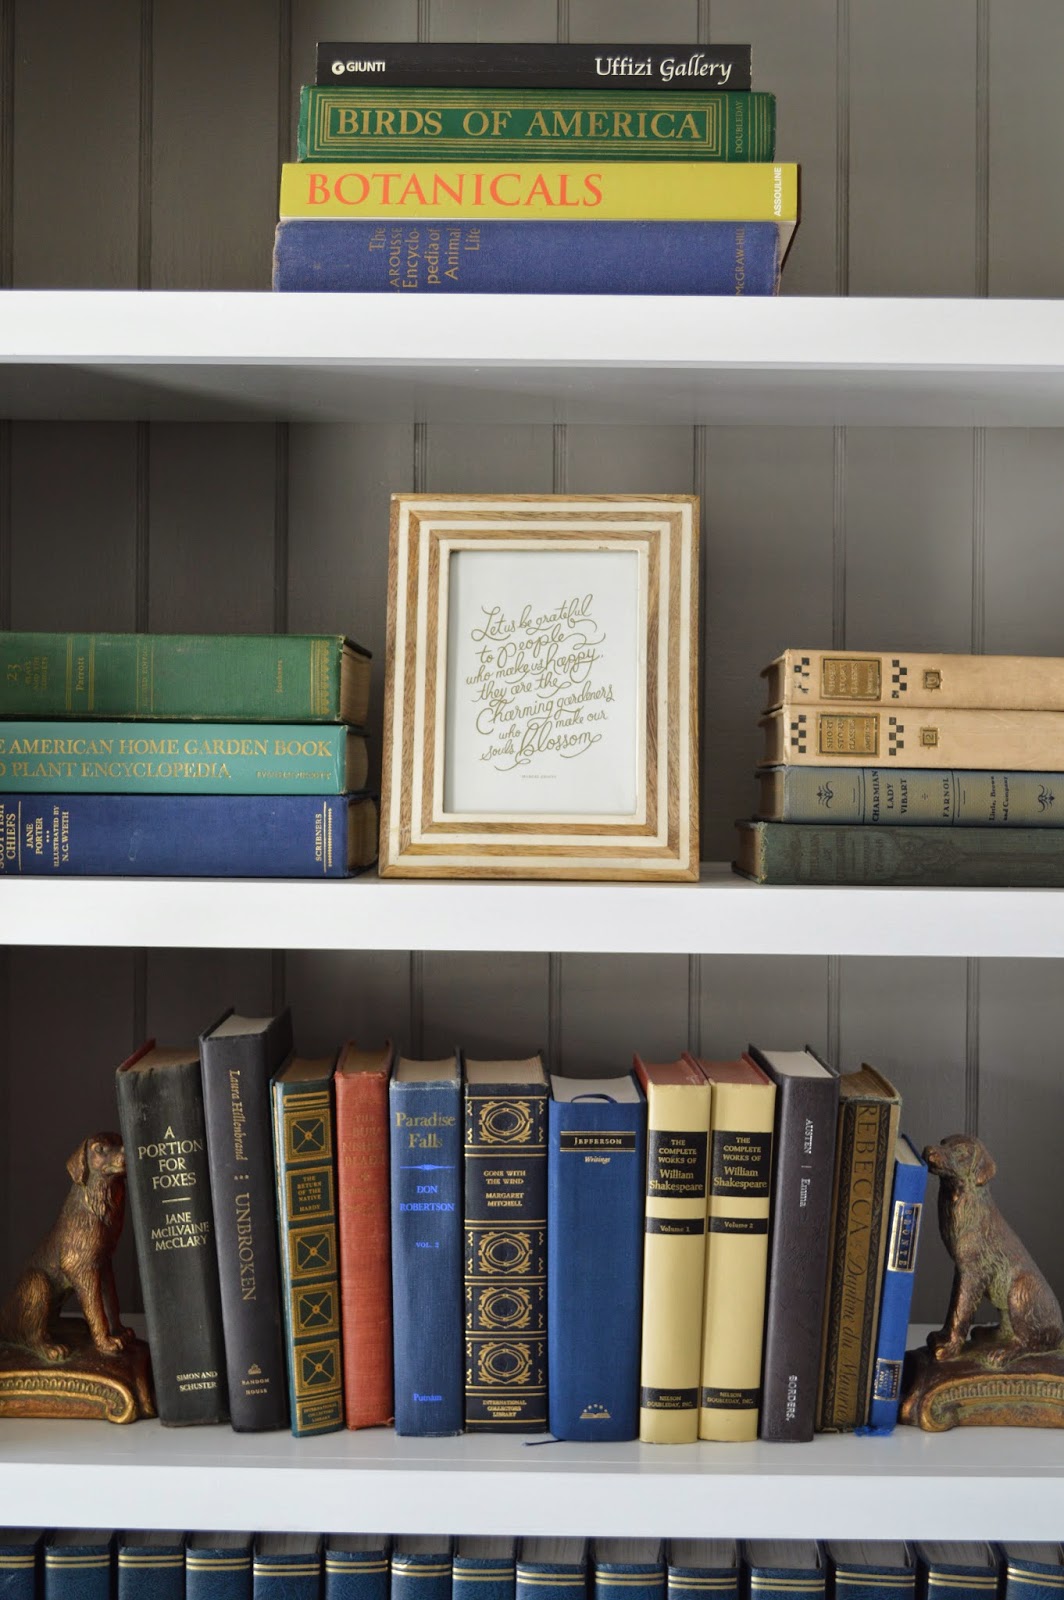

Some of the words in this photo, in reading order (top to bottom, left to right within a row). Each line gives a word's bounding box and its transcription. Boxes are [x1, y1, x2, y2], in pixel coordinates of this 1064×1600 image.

[346, 61, 386, 72] GIUNTI
[595, 56, 652, 76] Uffizi
[659, 53, 732, 85] Gallery
[336, 108, 443, 136] BIRDS
[462, 110, 512, 136] OF
[525, 110, 701, 139] AMERICA
[735, 100, 743, 153] DOUBLEDAY
[305, 173, 603, 207] BOTANICALS
[773, 167, 782, 217] ASSOULINE
[368, 227, 386, 252] The
[427, 227, 440, 240] of
[464, 228, 481, 251] Life
[389, 227, 402, 293] AROUSSE
[402, 228, 420, 288] Encyclo-
[424, 243, 441, 284] pedia
[444, 227, 461, 280] Animal
[526, 593, 598, 635] grateful
[475, 645, 494, 664] to
[75, 656, 84, 692] Parrott
[466, 664, 494, 685] who
[495, 651, 531, 684] make
[472, 680, 515, 704] they
[510, 681, 532, 695] are
[535, 671, 572, 698] the
[476, 698, 554, 735] Charming
[554, 680, 616, 720] gardeners
[498, 723, 521, 740] who
[555, 708, 584, 729] make
[586, 709, 608, 722] our
[9, 739, 113, 755] AMERICAN
[118, 739, 179, 755] HOME
[183, 739, 269, 756] GARDEN
[274, 739, 332, 757] BOOK
[479, 739, 515, 760] souls
[11, 761, 77, 777] PLANT
[81, 761, 231, 778] ENCYCLOPEDIA
[886, 783, 894, 810] LADY
[900, 778, 908, 814] VIBART
[53, 805, 60, 816] BY
[6, 813, 16, 860] CHIEFS
[26, 823, 34, 849] JANE
[35, 817, 43, 855] PORTER
[229, 1069, 240, 1100] Laura
[396, 1112, 456, 1127] Paradise
[163, 1125, 175, 1139] A
[231, 1101, 249, 1161] Hillenbrand
[408, 1133, 443, 1149] Falls
[574, 1137, 622, 1146] JEFFERSON
[803, 1118, 814, 1154] AUSTEN
[138, 1139, 204, 1160] PORTION
[584, 1155, 611, 1164] Writings
[723, 1145, 762, 1153] COMPLETE
[158, 1157, 187, 1172] FOR
[658, 1156, 685, 1164] WORKS
[850, 1104, 879, 1235] REBECCA
[152, 1172, 197, 1190] FOXES
[659, 1169, 694, 1179] William
[724, 1166, 759, 1176] William
[297, 1181, 322, 1189] RETURN
[416, 1185, 438, 1193] DON
[650, 1180, 703, 1192] Shakespeare
[713, 1177, 768, 1189] Shakespeare
[799, 1178, 811, 1208] Emma
[299, 1204, 321, 1212] HARDY
[400, 1203, 455, 1211] ROBERTSON
[165, 1211, 192, 1225] JANE
[724, 1221, 748, 1229] Volume
[235, 1192, 257, 1301] UNBROKEN
[415, 1241, 433, 1249] VOL.
[842, 1251, 868, 1320] Daphne
[841, 1326, 861, 1349] du
[176, 1371, 200, 1381] SIMON
[200, 1370, 218, 1379] AND
[241, 1377, 270, 1386] RANDOM
[179, 1381, 217, 1392] SCHUSTER
